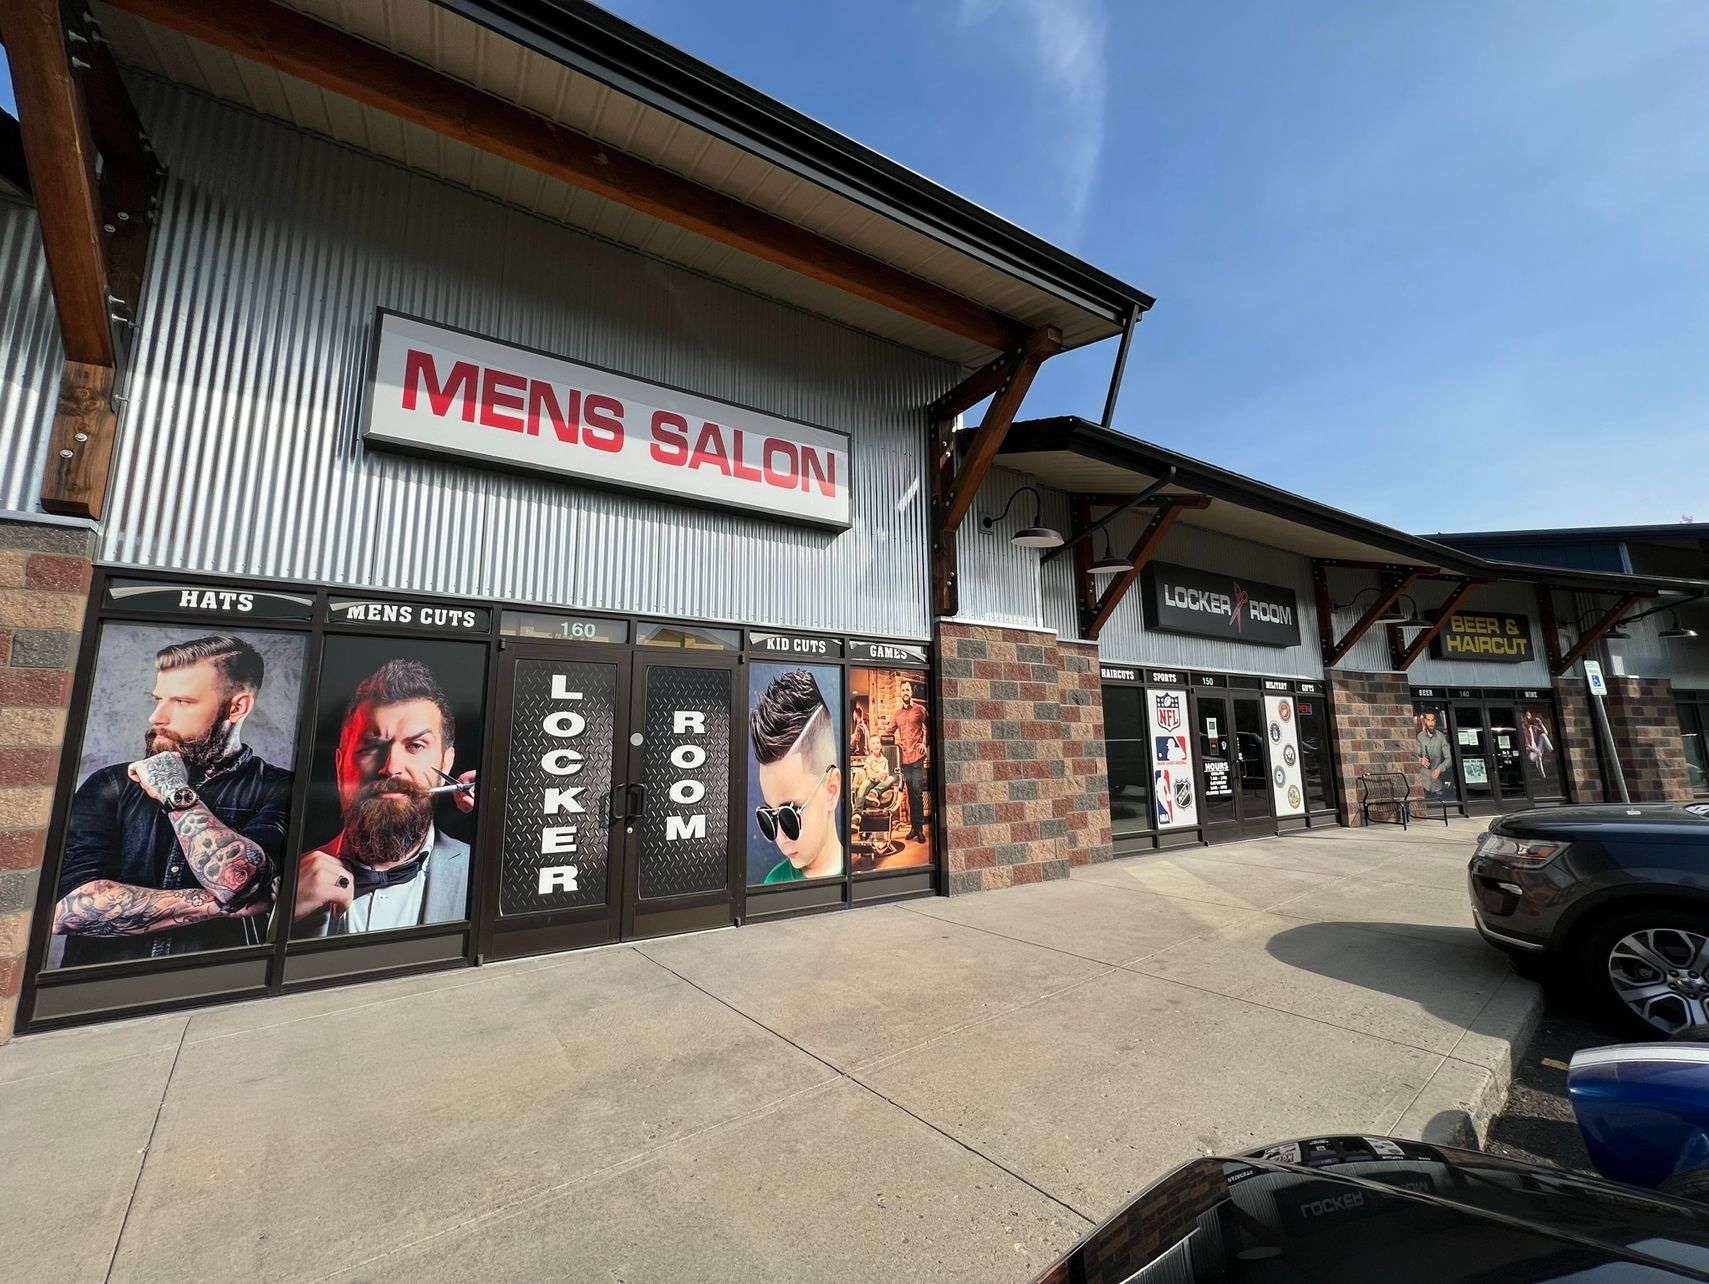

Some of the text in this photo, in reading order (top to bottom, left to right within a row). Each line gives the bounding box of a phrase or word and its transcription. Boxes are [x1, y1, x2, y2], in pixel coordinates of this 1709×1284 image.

[401, 348, 836, 498] MENS SALON
[179, 590, 254, 612] HATS
[1164, 583, 1293, 626] LOCKER ROOM
[346, 604, 476, 628] MENS CUTS
[560, 622, 596, 638] 160
[1450, 615, 1520, 635] BEER &
[766, 637, 827, 654] KID CUTS
[869, 645, 908, 660] GAMES
[1446, 634, 1527, 655] HAIRCUT
[1100, 668, 1135, 680] HAIRCUTS
[1152, 672, 1177, 683] SPORTS
[1202, 677, 1214, 686] 150
[1418, 689, 1433, 697] BEER
[1298, 703, 1312, 713] PEN
[1159, 709, 1179, 727] NFL
[1205, 762, 1229, 771] HOURS
[666, 710, 706, 841] ROOM
[538, 674, 587, 895] LOCKER
